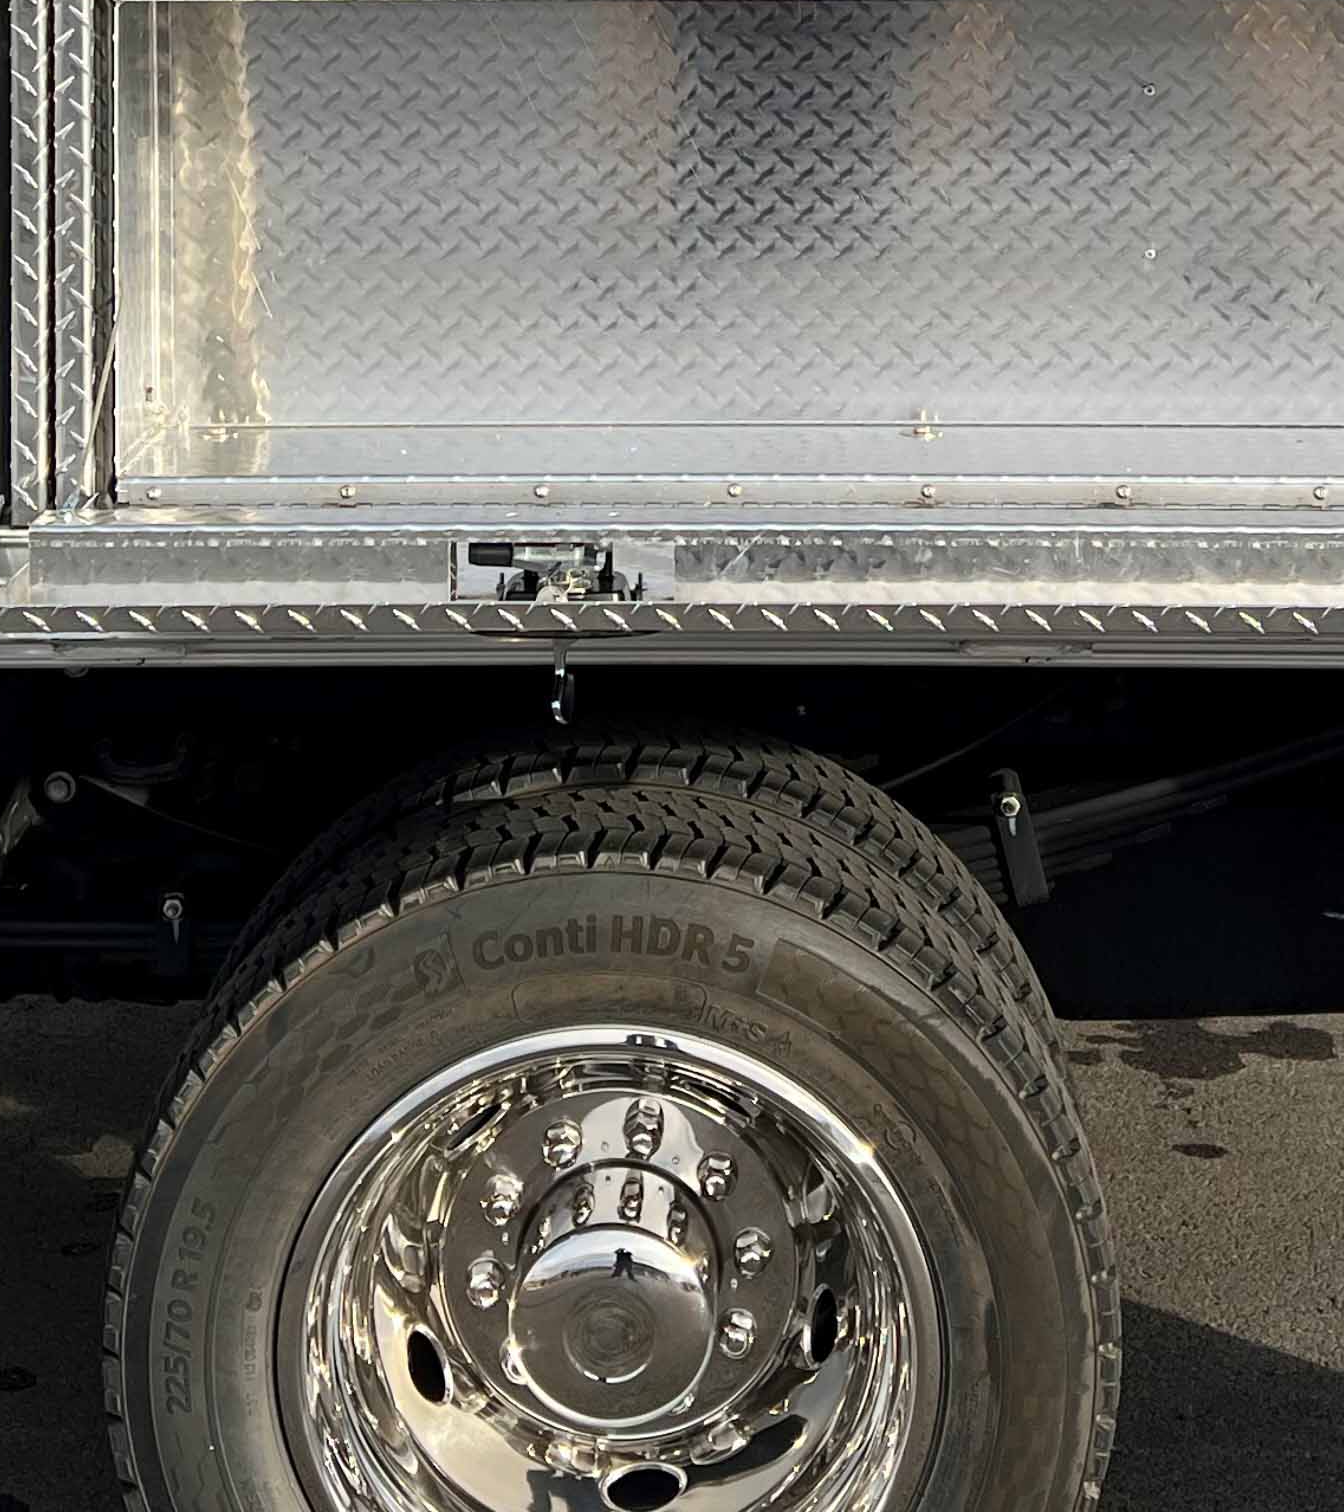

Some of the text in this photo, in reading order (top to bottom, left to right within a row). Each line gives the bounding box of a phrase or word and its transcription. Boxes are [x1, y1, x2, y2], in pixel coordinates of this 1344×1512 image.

[472, 914, 755, 974] Conti HDR 5
[164, 1197, 215, 1415] 225/70 R 19.5
